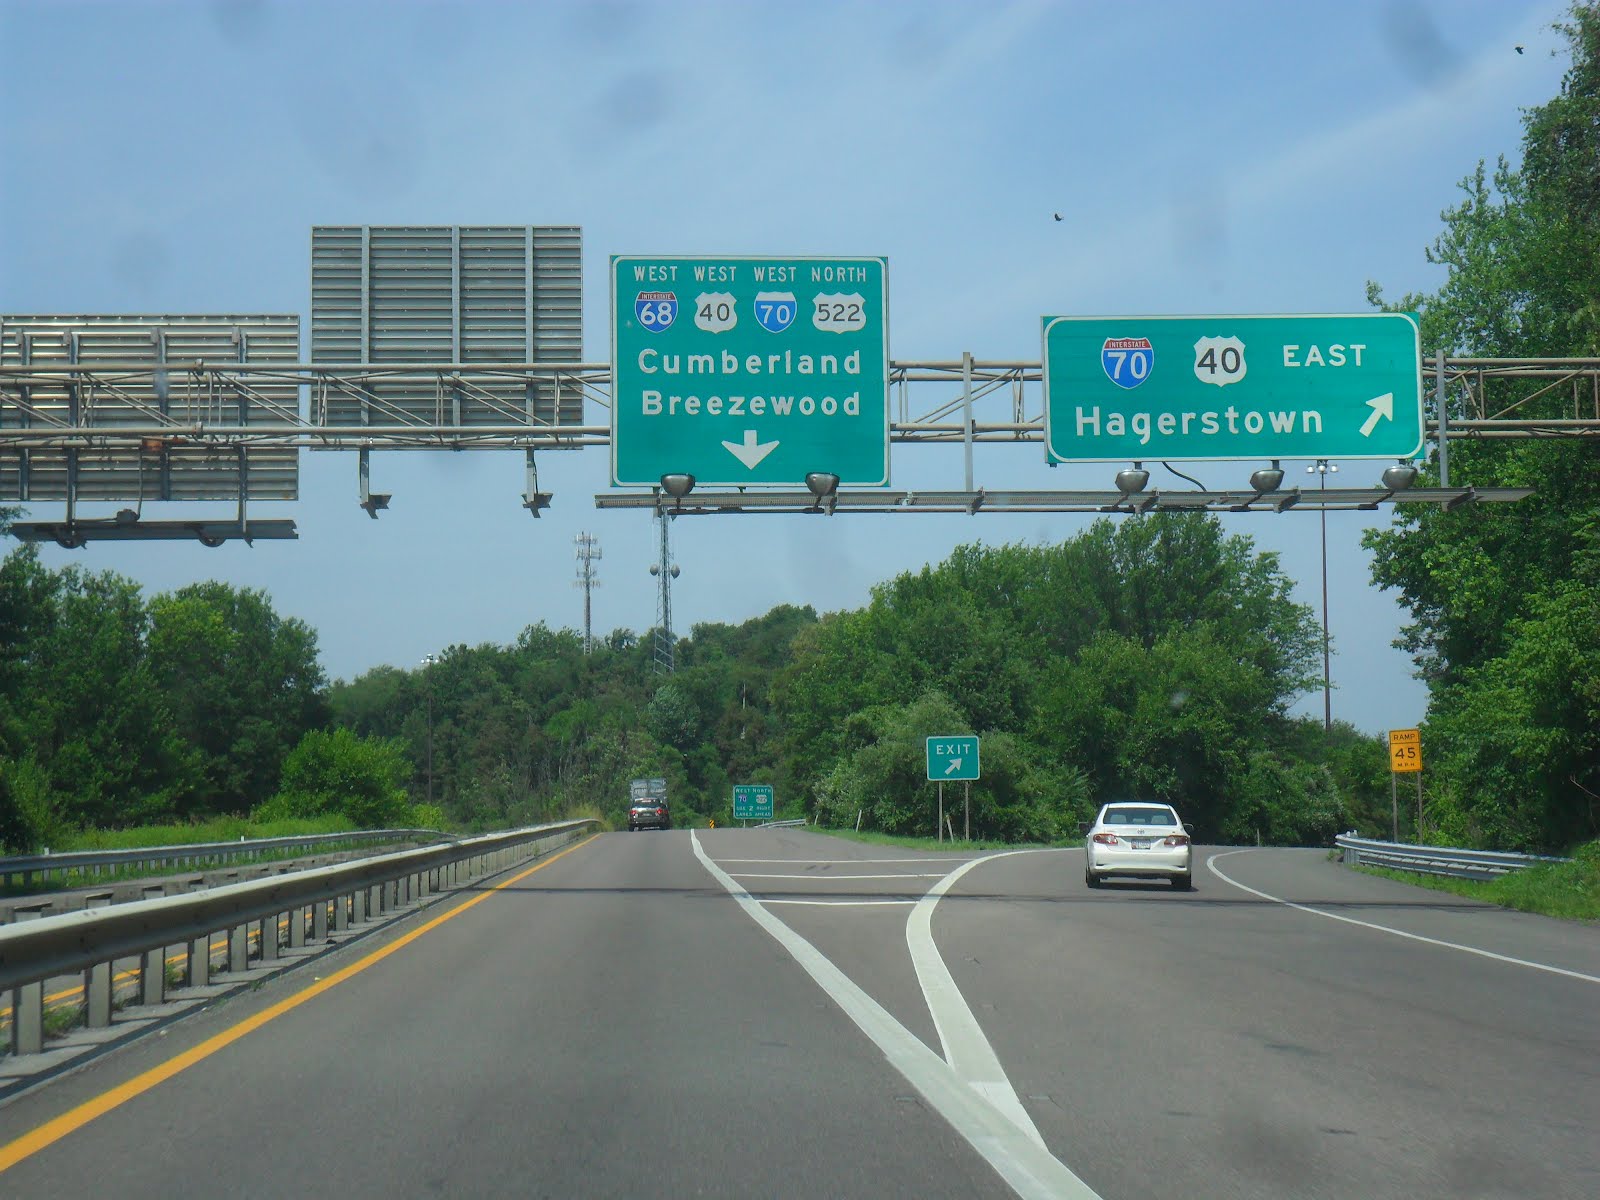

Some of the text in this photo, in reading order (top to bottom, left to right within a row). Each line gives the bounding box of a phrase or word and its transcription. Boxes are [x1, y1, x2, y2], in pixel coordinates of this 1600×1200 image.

[634, 266, 678, 282] WEST
[694, 266, 737, 282] WEST
[754, 266, 797, 282] WEST
[811, 267, 867, 282] NORTH
[640, 302, 673, 325] 68
[699, 303, 730, 322] 40
[760, 305, 791, 324] 70
[818, 303, 861, 322] 522
[1108, 340, 1146, 348] INTERSTATE
[638, 348, 861, 374] Cumberland
[1197, 347, 1241, 374] 40
[1283, 344, 1366, 367] EAST
[1107, 351, 1147, 380] 70
[642, 390, 860, 416] Breezewood
[1075, 405, 1323, 445] Hagerstown
[936, 744, 970, 755] EXIT
[1395, 747, 1416, 759] 45
